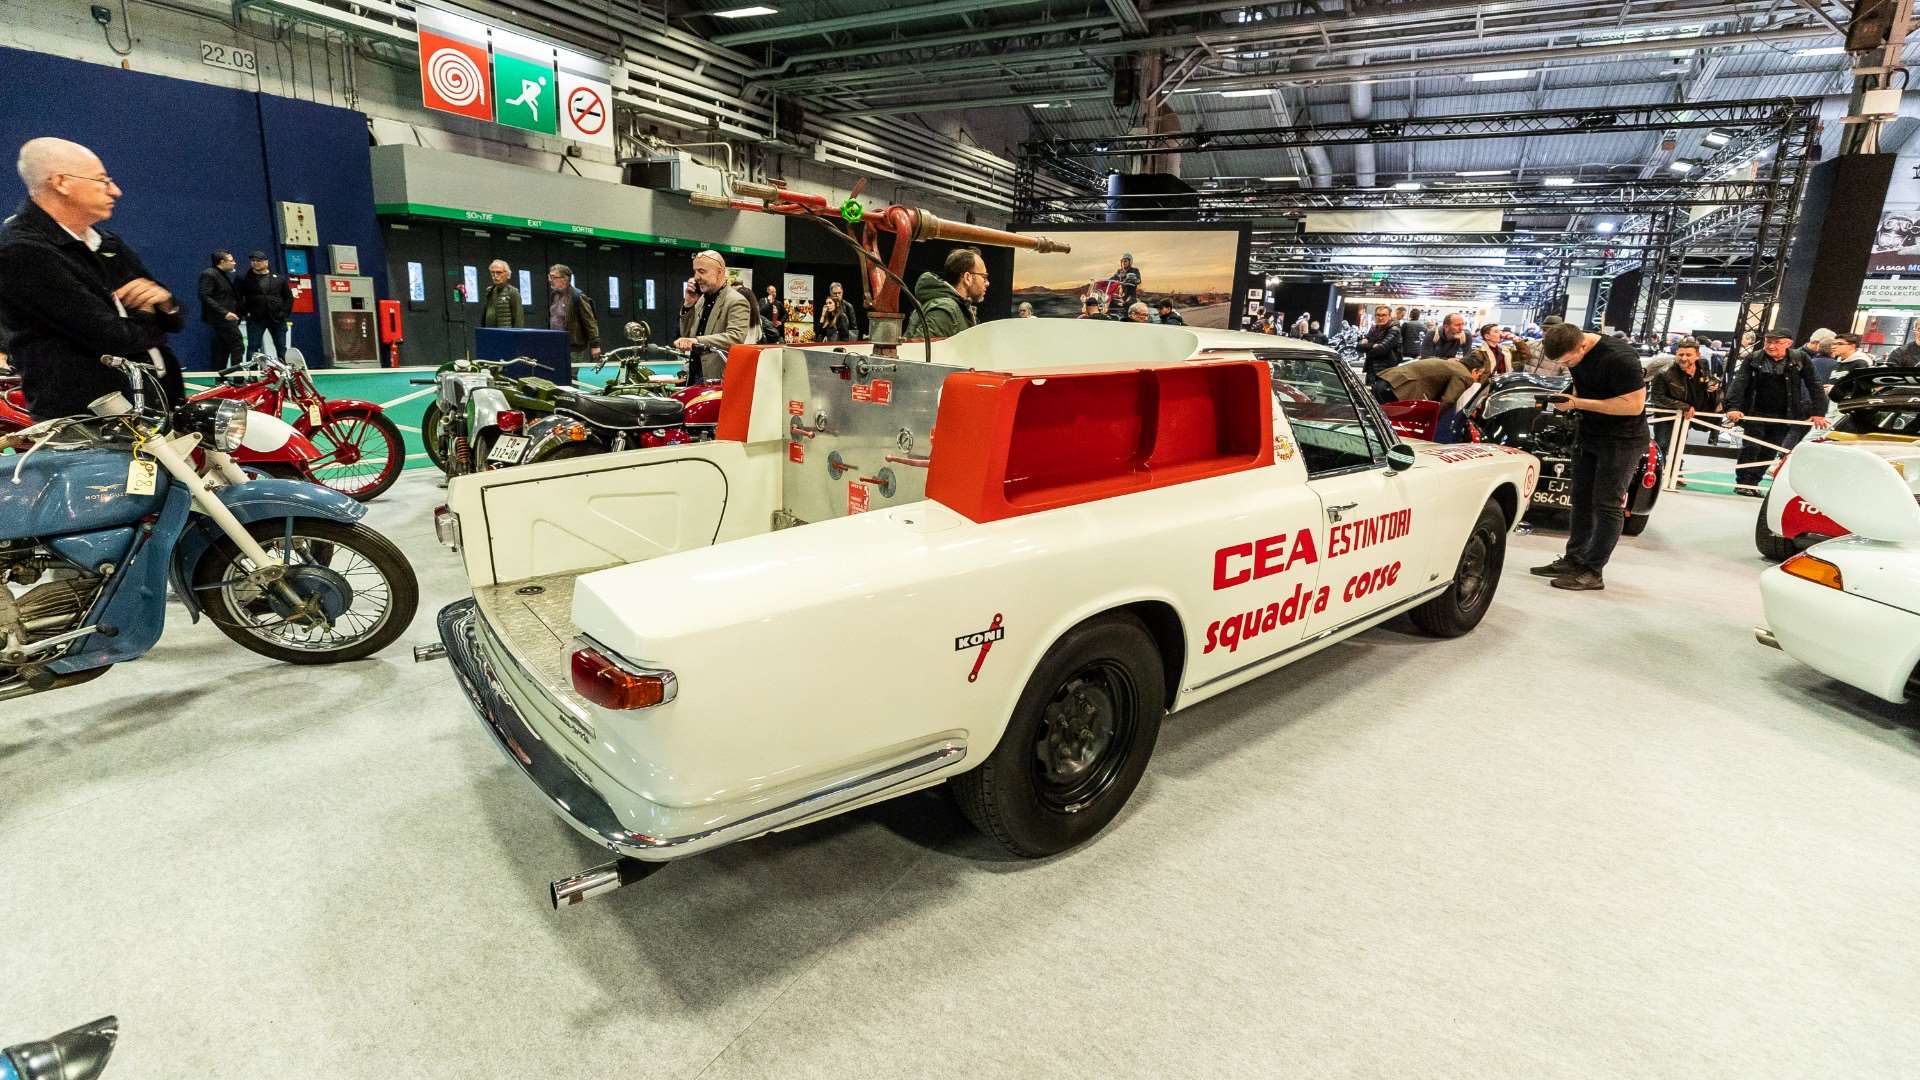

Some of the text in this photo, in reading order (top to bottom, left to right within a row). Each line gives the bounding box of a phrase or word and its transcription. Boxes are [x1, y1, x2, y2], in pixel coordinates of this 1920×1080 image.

[203, 44, 254, 69] 22.03
[1533, 492, 1573, 506] 964-QL
[1213, 508, 1411, 591] CEA ESTINTORI
[1203, 561, 1401, 655] squadra corse
[958, 629, 1002, 649] KONI
